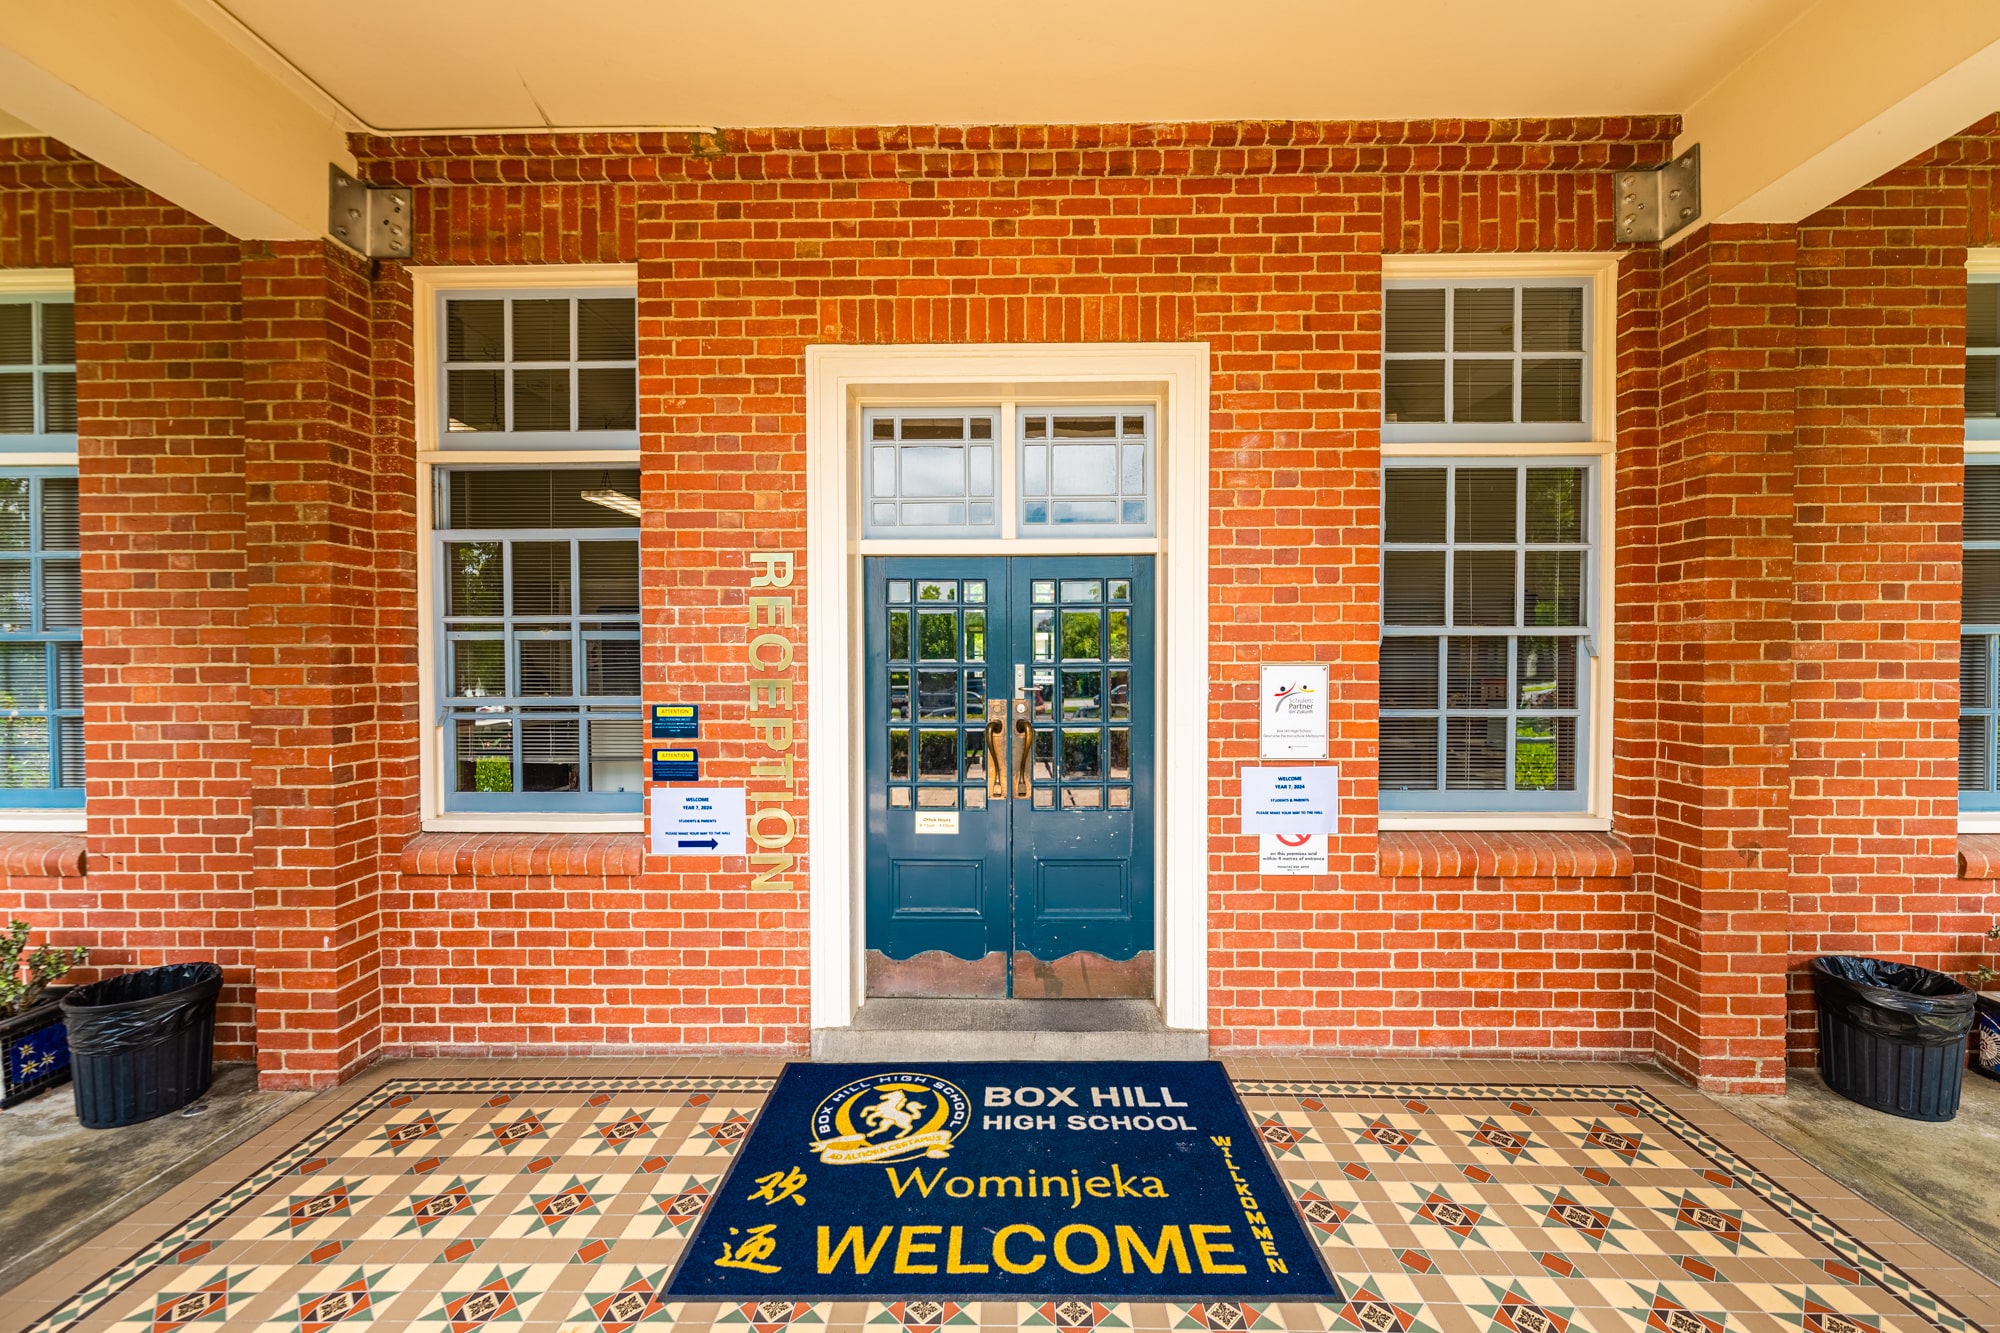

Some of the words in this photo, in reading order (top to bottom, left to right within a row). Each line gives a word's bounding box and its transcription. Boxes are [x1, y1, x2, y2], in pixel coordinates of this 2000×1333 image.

[749, 552, 795, 892] RECEPTION
[818, 1106, 834, 1134] BOX
[832, 1082, 871, 1102] HILL
[879, 1075, 927, 1084] HIGH
[932, 1081, 966, 1128] SCHOOL
[983, 1086, 1078, 1108] BOX
[1091, 1086, 1189, 1108] HILL
[983, 1114, 1055, 1131] HIGH
[1068, 1114, 1197, 1131] SCHOOL
[844, 1147, 889, 1161] ALTIORA
[888, 1134, 942, 1152] CERTAMUS
[884, 1163, 1169, 1209] Wominjeka
[1210, 1135, 1289, 1274] WILLKOMMEN
[816, 1223, 1247, 1275] WELCOME
